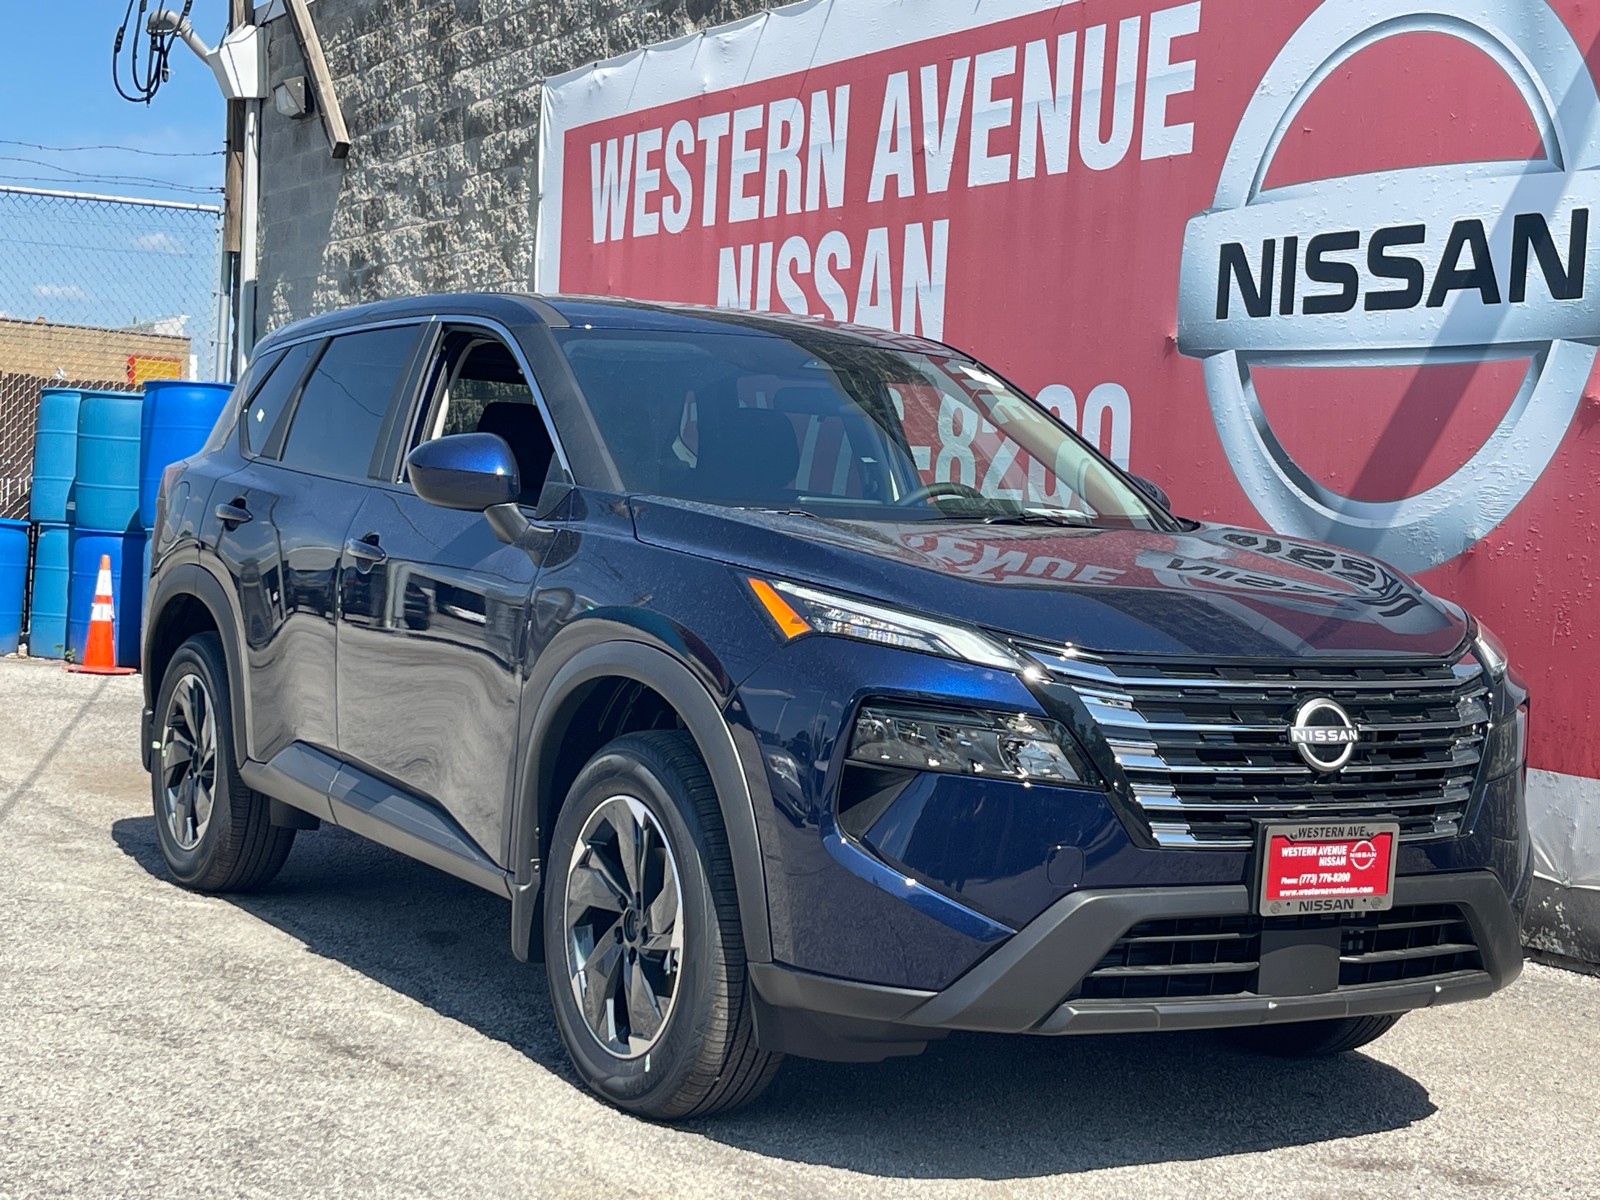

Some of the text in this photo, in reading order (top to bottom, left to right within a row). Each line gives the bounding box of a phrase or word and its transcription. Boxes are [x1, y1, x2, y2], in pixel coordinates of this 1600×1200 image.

[590, 1, 1201, 244] WESTERN AVENUE
[1216, 208, 1589, 320] NISSAN
[717, 219, 949, 342] NISSAN
[1292, 729, 1359, 742] NISSAN
[1298, 827, 1345, 838] WESTERN
[1281, 845, 1348, 857] WESTERN AVENUE
[1319, 856, 1346, 867] NISSAN
[1299, 873, 1317, 885] (773)
[1319, 872, 1351, 883] 776-8200
[1299, 899, 1354, 912] NISSAN
